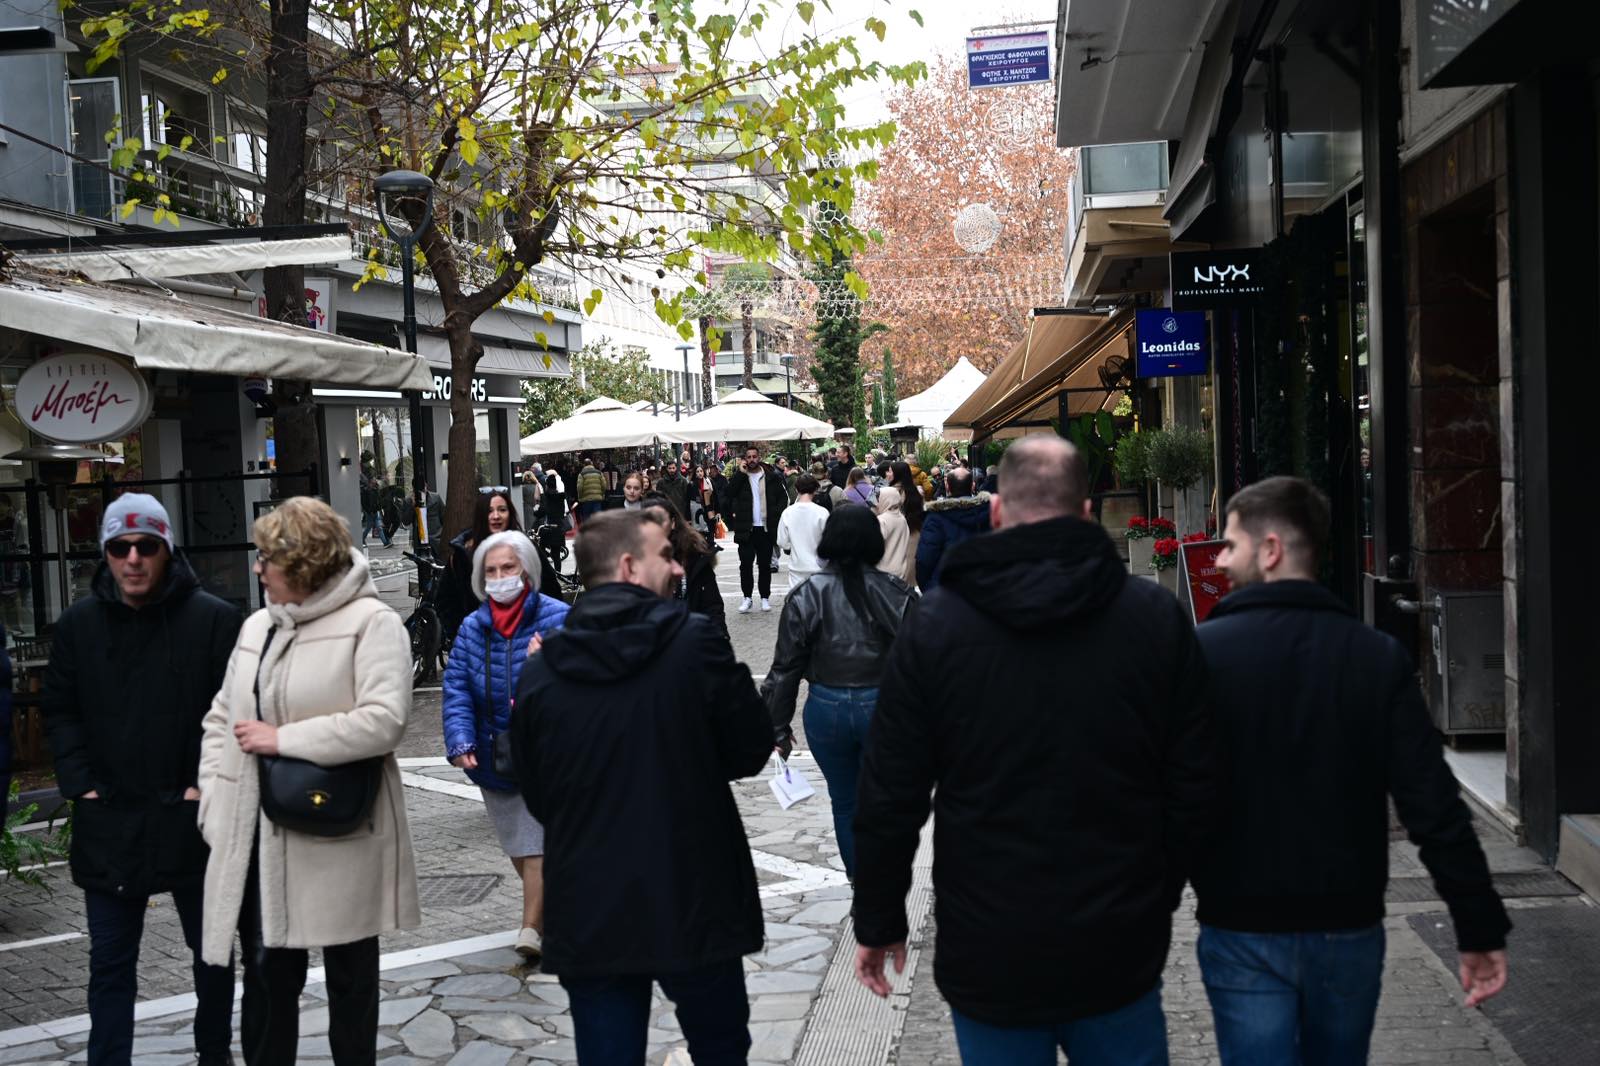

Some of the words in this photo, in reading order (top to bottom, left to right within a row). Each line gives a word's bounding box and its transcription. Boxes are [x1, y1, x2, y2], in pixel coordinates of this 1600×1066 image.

[988, 58, 1029, 66] ΧΕΙΡΟΥΡΓΟΣ
[981, 70, 1002, 78] ΦΩΤΗΣ
[1010, 67, 1037, 75] ΜΑΝΤΖΟΣ
[989, 74, 1029, 82] ΧΕΙΡΟΥΡΓΟΣ
[1194, 264, 1250, 287] NYX
[1174, 288, 1235, 296] PROFESSIONAL
[1142, 340, 1201, 353] Leonidas
[46, 363, 106, 378] ΚΡΕΠΕΣ
[422, 375, 486, 401] RORS
[31, 379, 132, 424] Μποέμ
